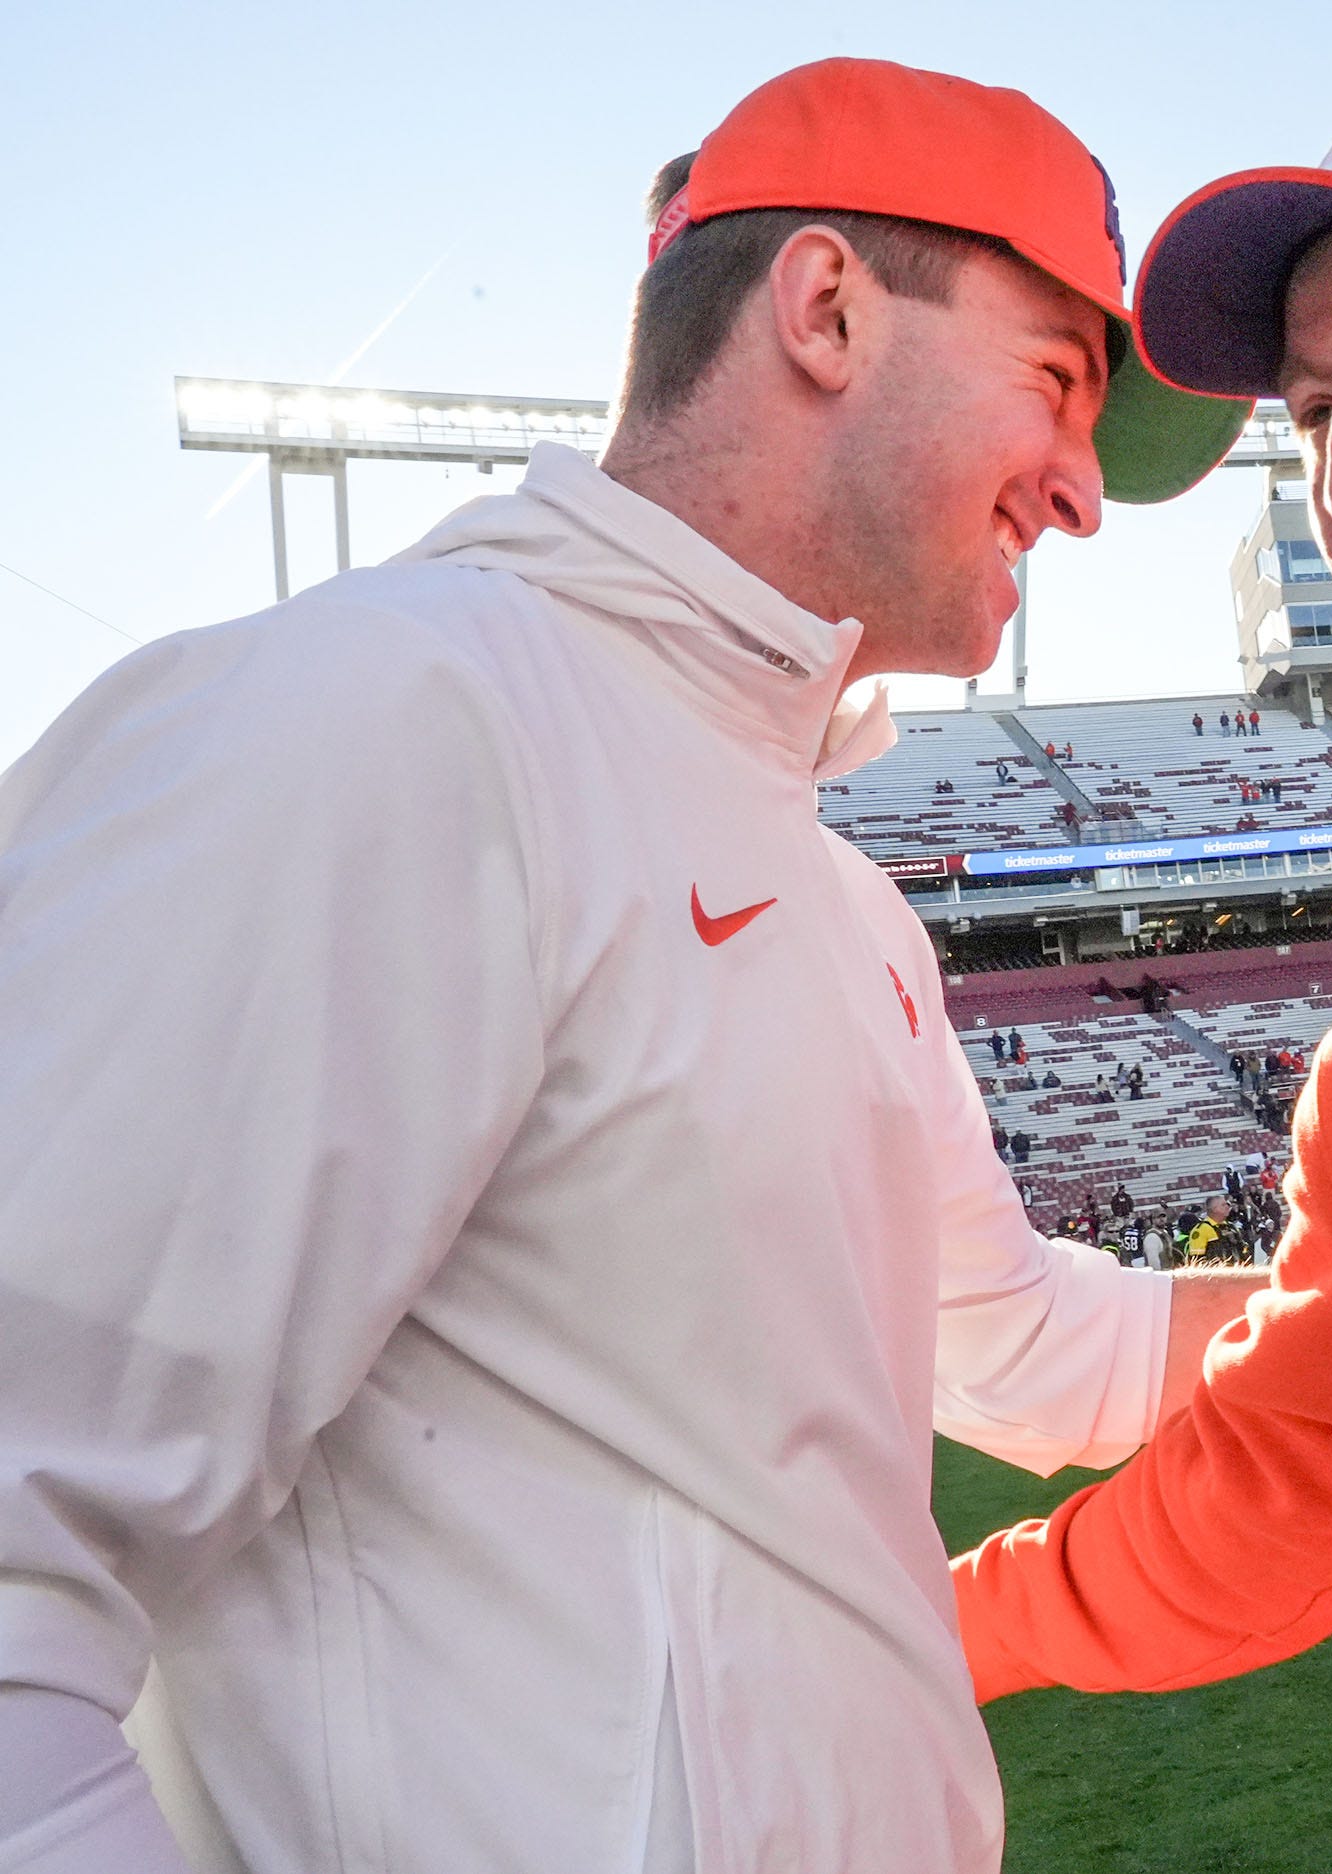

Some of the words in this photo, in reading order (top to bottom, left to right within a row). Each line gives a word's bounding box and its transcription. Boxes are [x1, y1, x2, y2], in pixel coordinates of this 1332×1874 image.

[1005, 853, 1076, 869] ticketmaster
[1105, 847, 1174, 861] ticketmaster
[1203, 838, 1271, 854] ticketmaster
[1311, 984, 1320, 994] 7
[976, 1017, 986, 1027] 8
